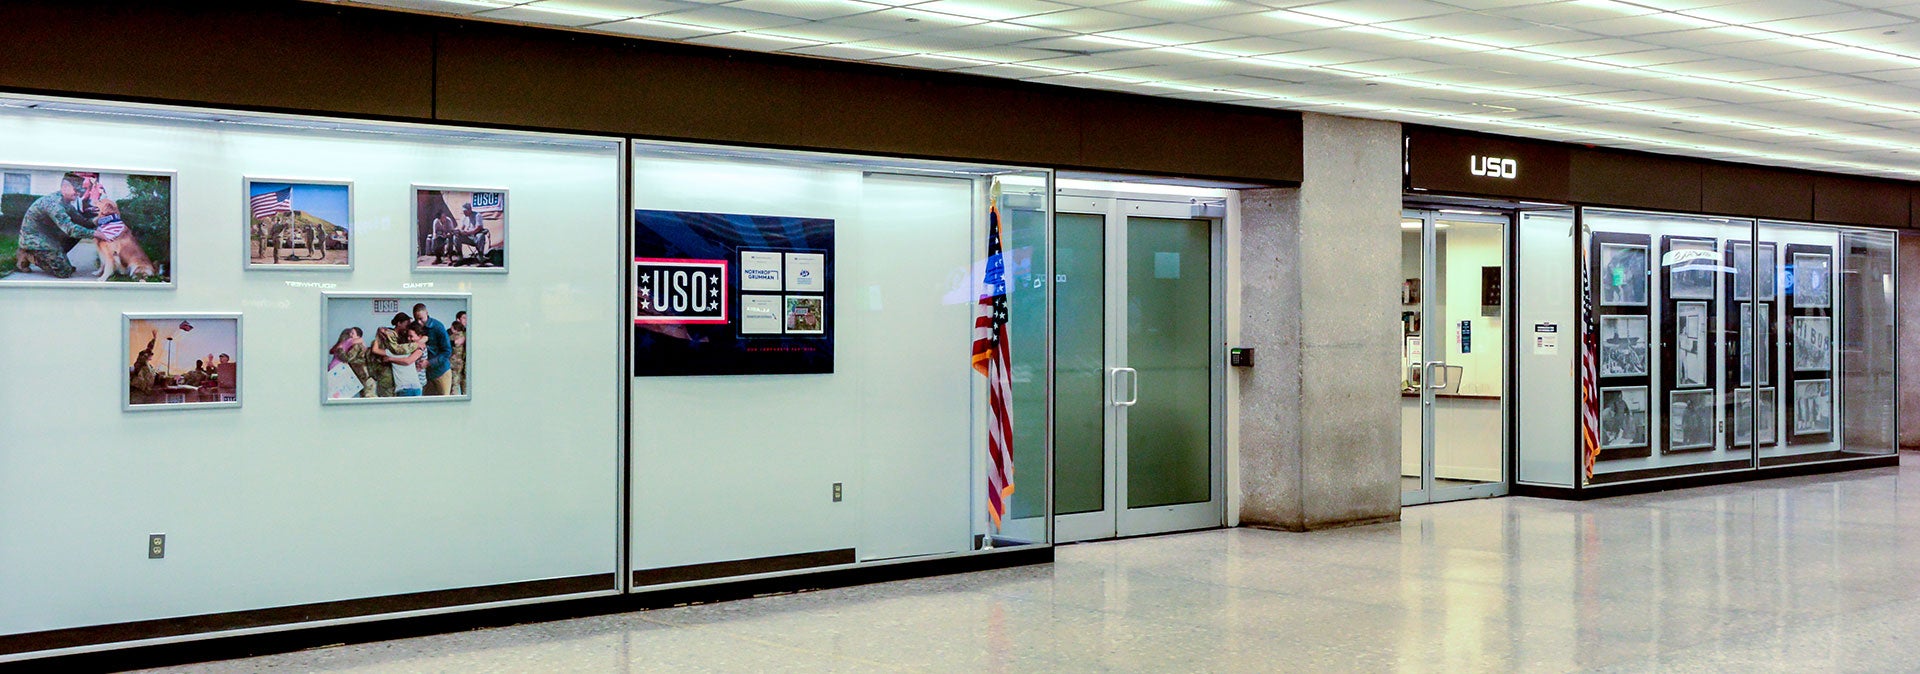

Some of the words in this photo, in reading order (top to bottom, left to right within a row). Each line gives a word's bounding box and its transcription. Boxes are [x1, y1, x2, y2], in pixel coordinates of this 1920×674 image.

[1471, 155, 1517, 179] USO
[477, 193, 494, 206] USO
[653, 270, 706, 312] USO
[378, 300, 395, 311] USO
